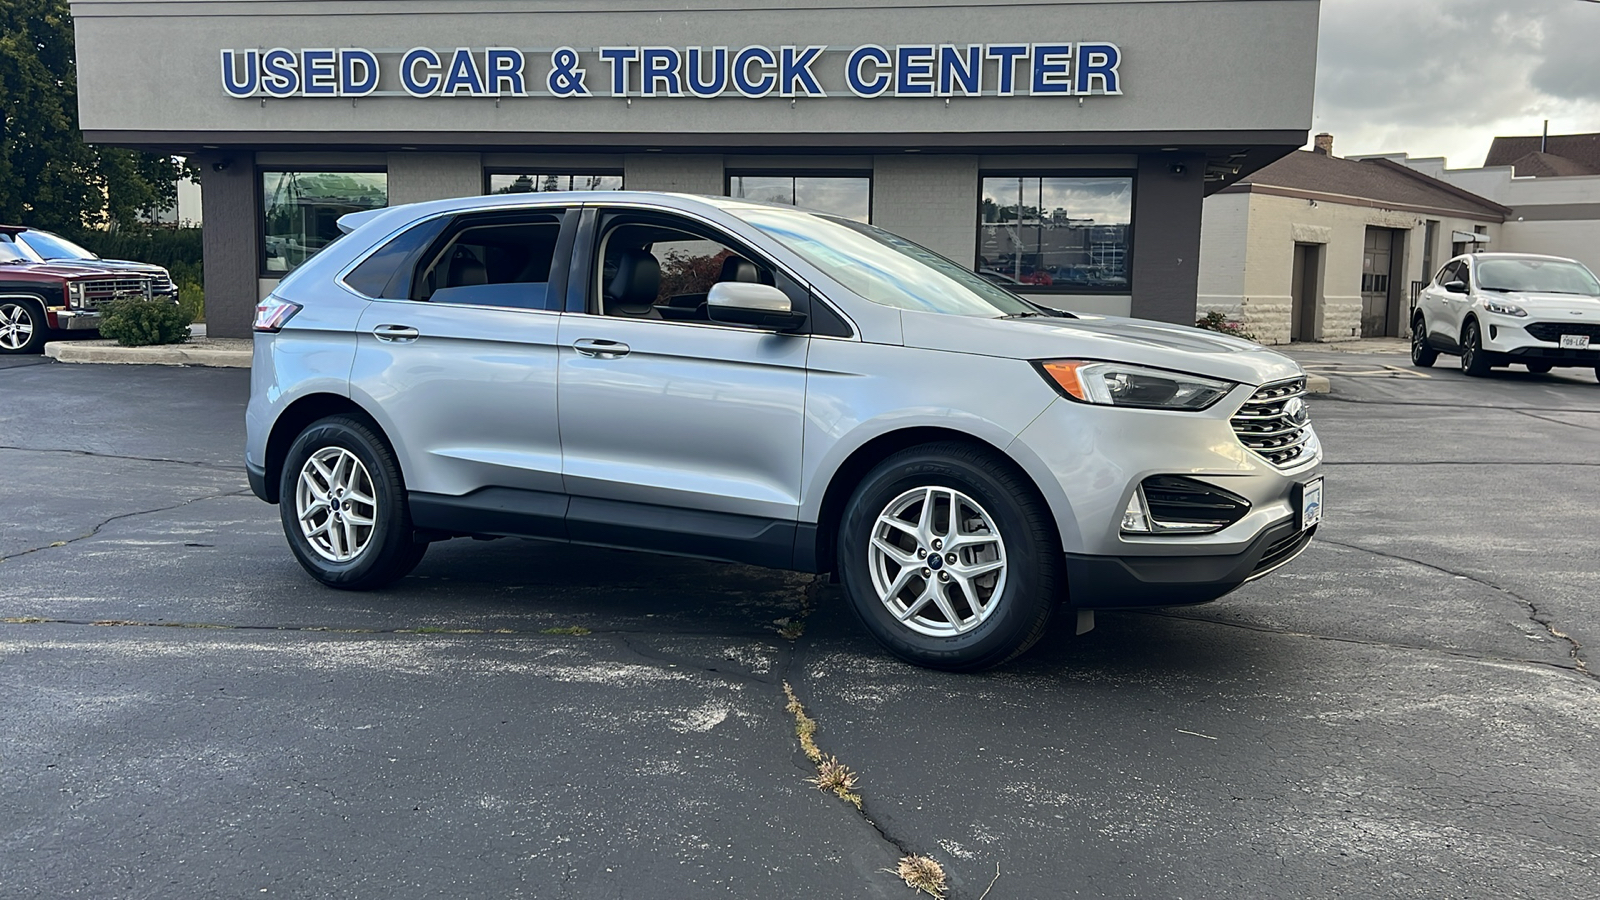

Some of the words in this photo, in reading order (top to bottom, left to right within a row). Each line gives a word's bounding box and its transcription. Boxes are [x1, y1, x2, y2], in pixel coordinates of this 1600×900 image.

[221, 47, 379, 98] USED
[400, 47, 528, 98] CAR
[546, 46, 593, 98] &
[599, 44, 827, 98] TRUCK
[845, 42, 1123, 98] CENTER
